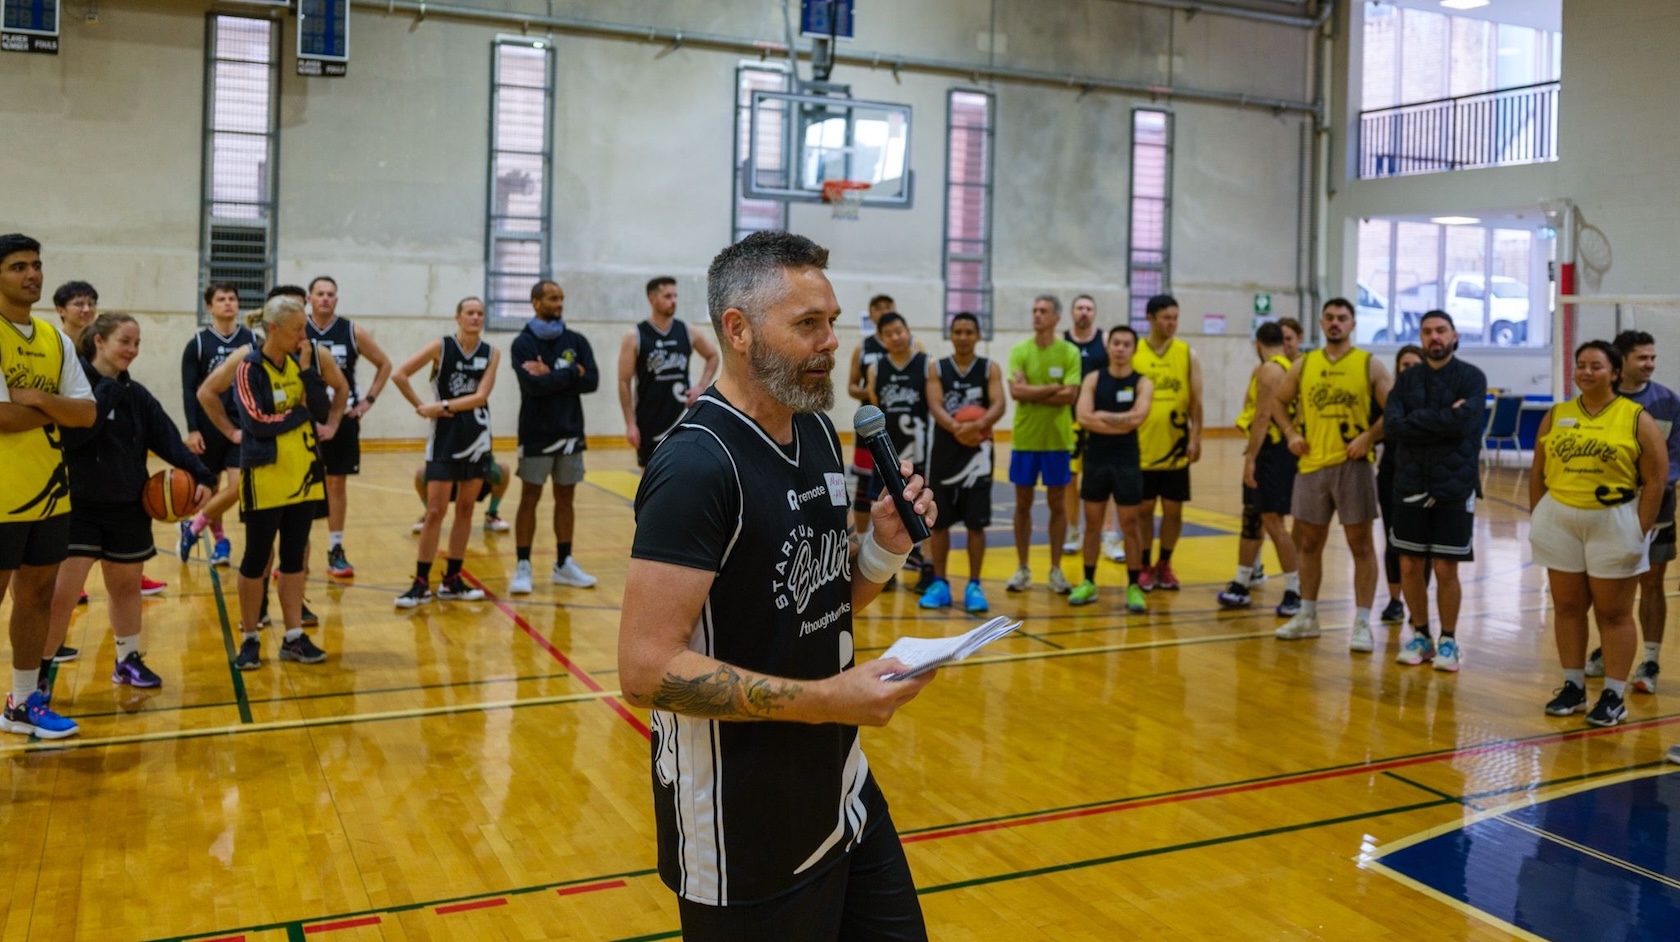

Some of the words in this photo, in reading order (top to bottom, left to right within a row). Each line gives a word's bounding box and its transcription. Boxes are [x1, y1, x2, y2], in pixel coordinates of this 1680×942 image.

[797, 485, 826, 504] remote
[772, 524, 814, 610] STARTUP
[787, 529, 851, 615] Baller
